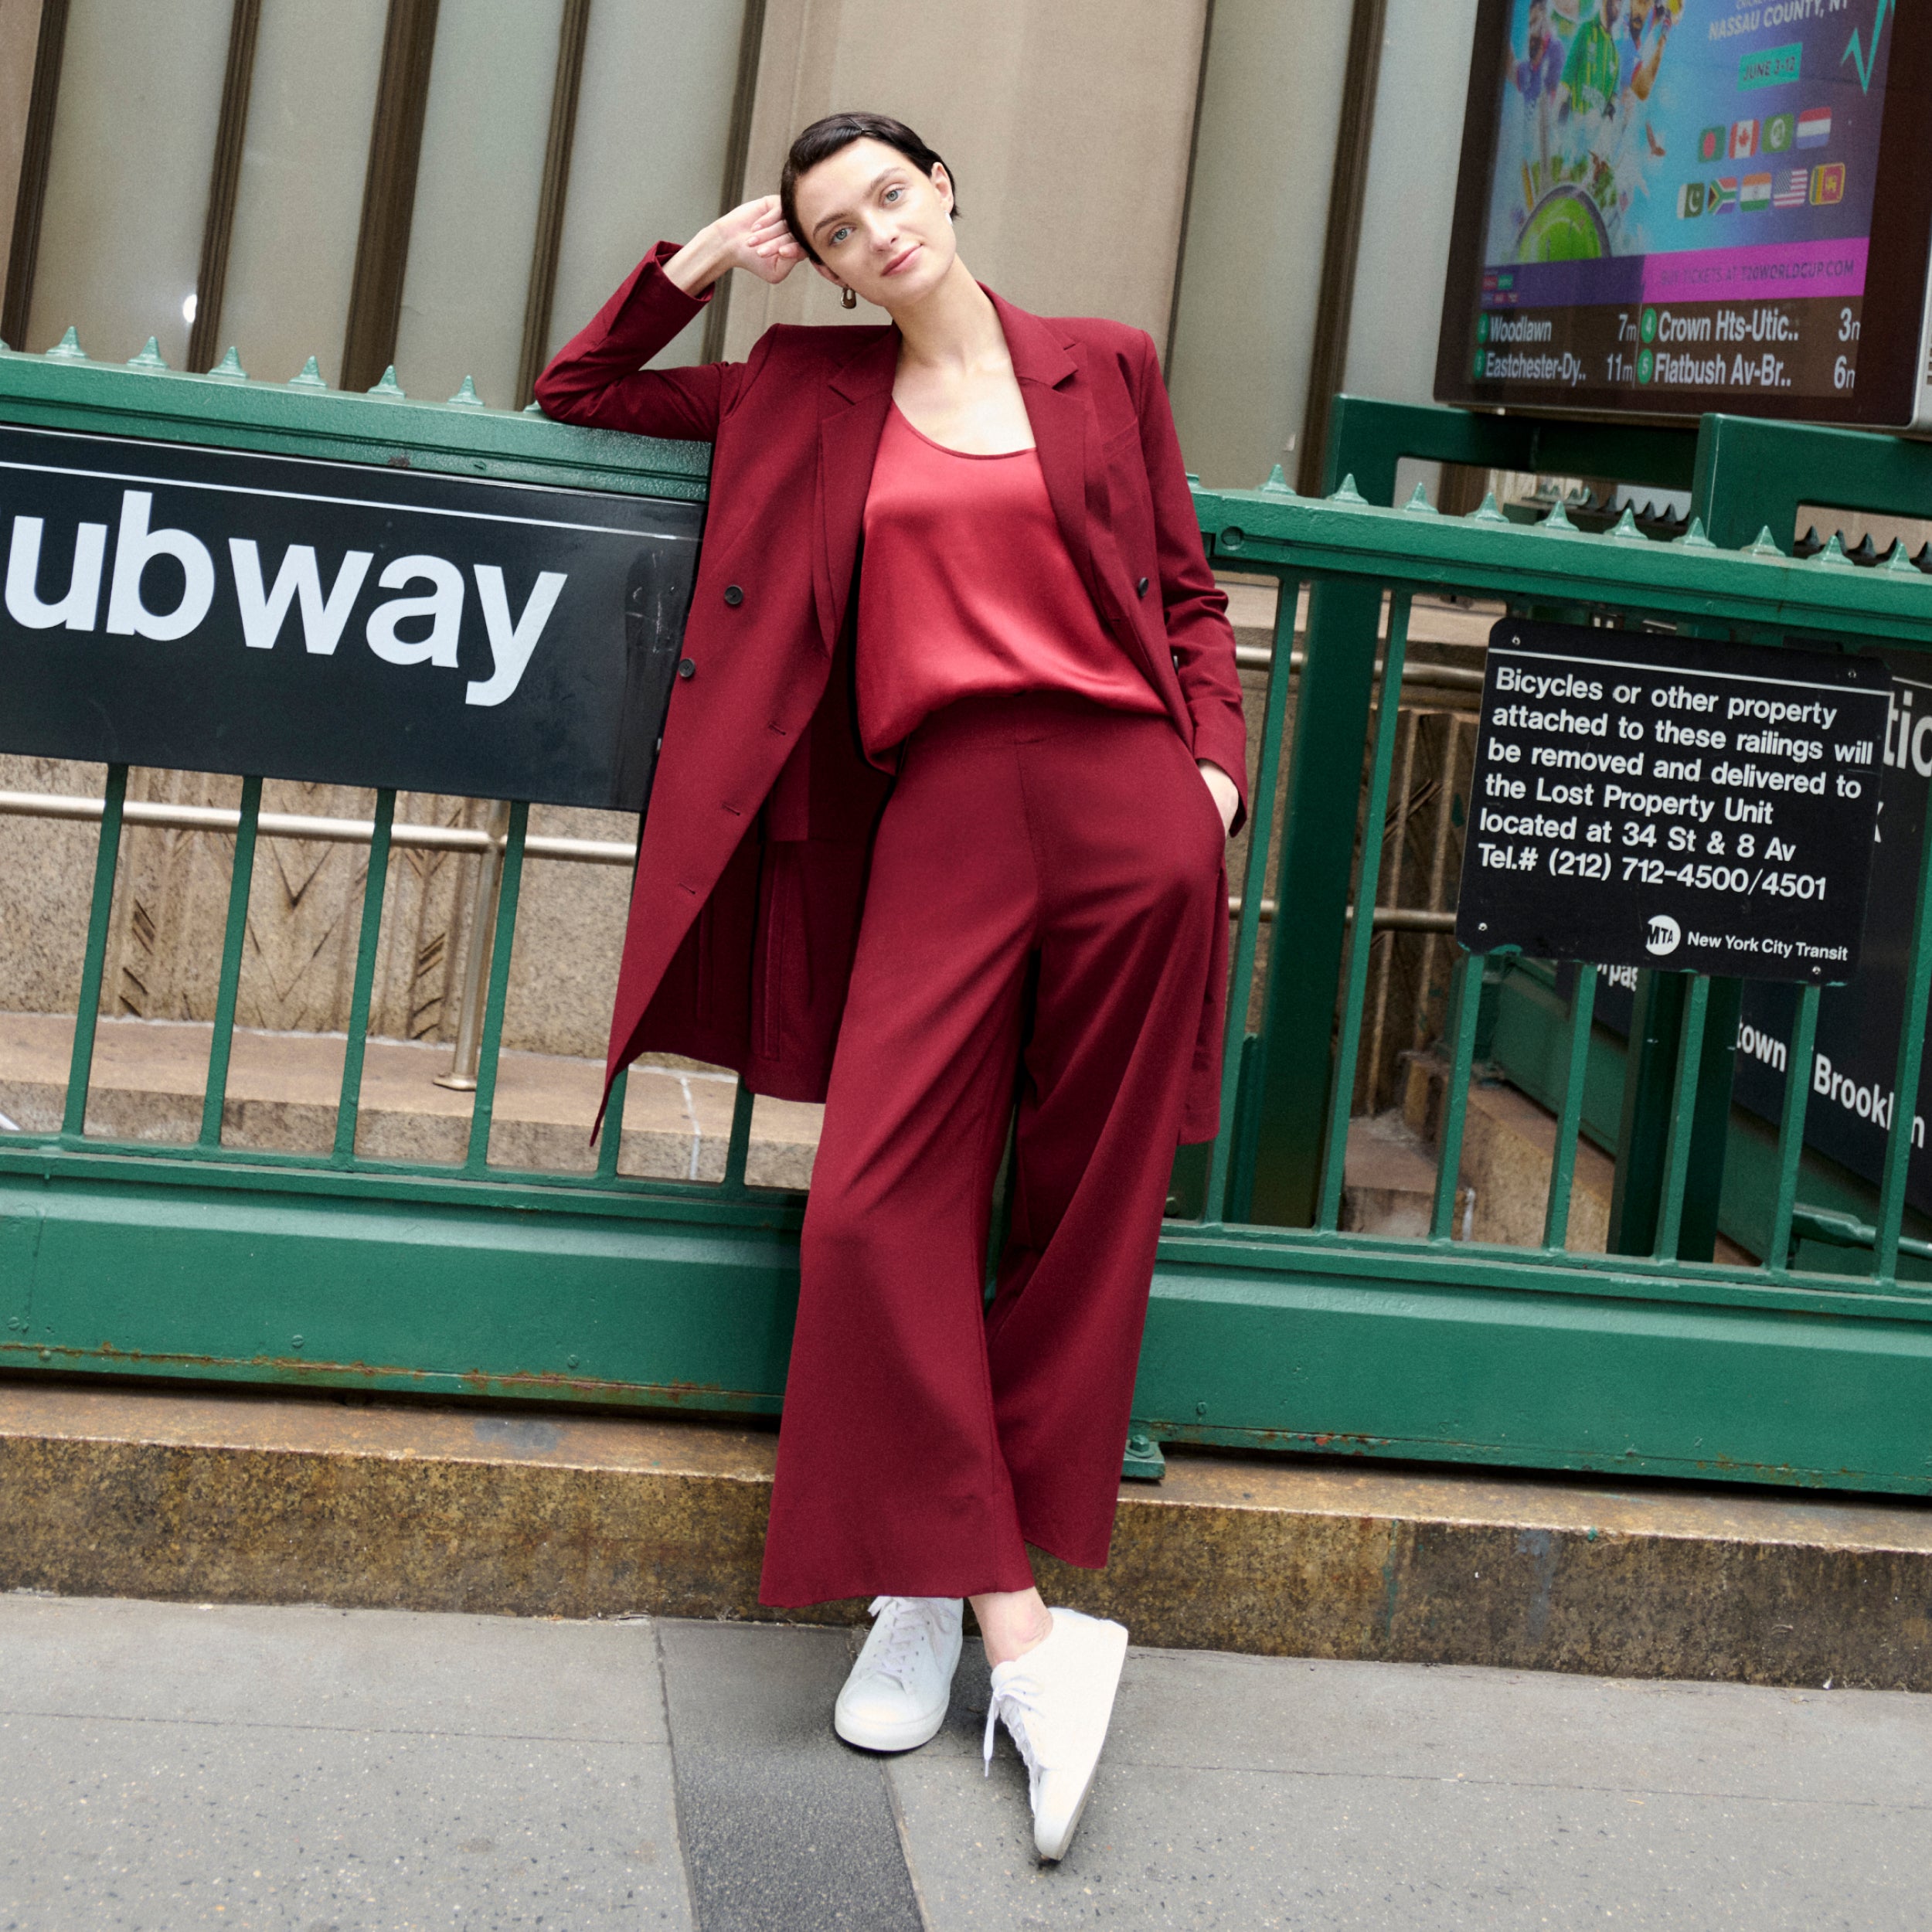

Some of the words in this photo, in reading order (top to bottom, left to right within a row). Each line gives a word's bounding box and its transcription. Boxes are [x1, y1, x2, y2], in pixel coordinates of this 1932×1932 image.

[1708, 9, 1760, 41] NASSAU
[1764, 0, 1825, 28] COUNTY,
[1743, 60, 1772, 81] JUNE
[1774, 56, 1795, 75] 3-12
[1682, 267, 1723, 284] TICKETS
[1726, 267, 1738, 281] AT
[1740, 260, 1855, 281] T20WORLDCUP.COM
[1490, 315, 1552, 342] Woodlawn
[1658, 311, 1711, 342] Crown
[1715, 308, 1799, 342] Hts-Utic..
[1654, 352, 1726, 386] Flatbush
[1730, 353, 1791, 387] Av-Br..
[4, 491, 569, 706] ubway
[1496, 666, 1603, 700] Bicycles
[1613, 685, 1641, 704] or
[1651, 685, 1719, 712] other
[1727, 696, 1838, 730] property
[1492, 704, 1608, 736] attached
[1618, 716, 1644, 740] to
[1655, 720, 1726, 749] these
[1736, 730, 1823, 764] railings
[1834, 740, 1873, 765] will
[1488, 736, 1521, 763] be
[1531, 747, 1644, 775] removed
[1653, 758, 1702, 782] and
[1711, 761, 1826, 794] delivered
[1836, 774, 1862, 798] to
[1485, 773, 1526, 799] the
[1536, 777, 1594, 806] Lost
[1604, 784, 1715, 823] Property
[1724, 797, 1774, 825] Unit
[1479, 808, 1577, 840] located
[1586, 821, 1612, 843] at
[1622, 822, 1657, 848] 34
[1667, 826, 1696, 852] St
[1706, 830, 1725, 855] &
[1736, 833, 1755, 858] 8
[1764, 836, 1797, 862] Av
[1478, 843, 1539, 871] Tel.#
[1549, 848, 1611, 881] (212)
[1622, 857, 1827, 900] 712-4500/4501
[1688, 931, 1722, 948] New
[1725, 934, 1759, 952] York
[1761, 938, 1793, 959] City
[1795, 941, 1849, 961] Transit
[1814, 1053, 1925, 1149] Brookln
